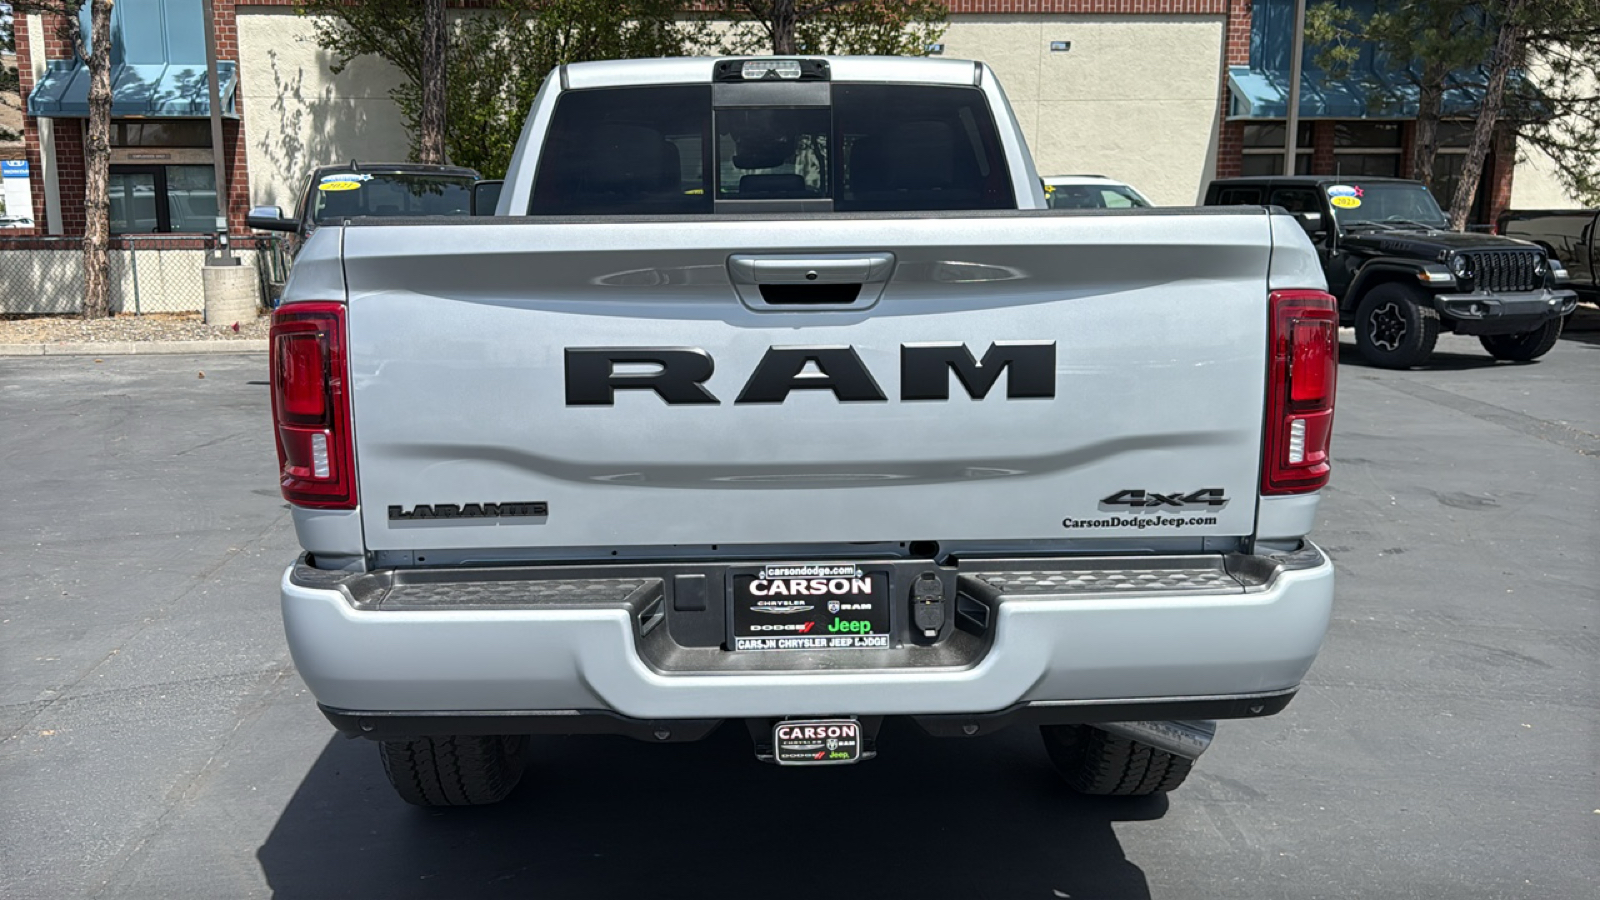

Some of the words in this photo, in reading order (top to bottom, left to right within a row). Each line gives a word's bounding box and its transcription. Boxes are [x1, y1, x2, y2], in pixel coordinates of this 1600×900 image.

[564, 340, 1057, 406] RAM
[1100, 488, 1231, 507] 4x4
[388, 501, 548, 520] LARAMIE
[1062, 516, 1217, 529] CarsonDodgeJeep.com
[768, 566, 854, 577] carsondodge.com
[749, 578, 871, 595] CARSON
[828, 617, 870, 635] Jeep
[778, 638, 827, 648] CHRYSLER
[829, 636, 853, 647] JEEP
[779, 726, 855, 739] CARSON
[829, 750, 849, 759] Jeep
